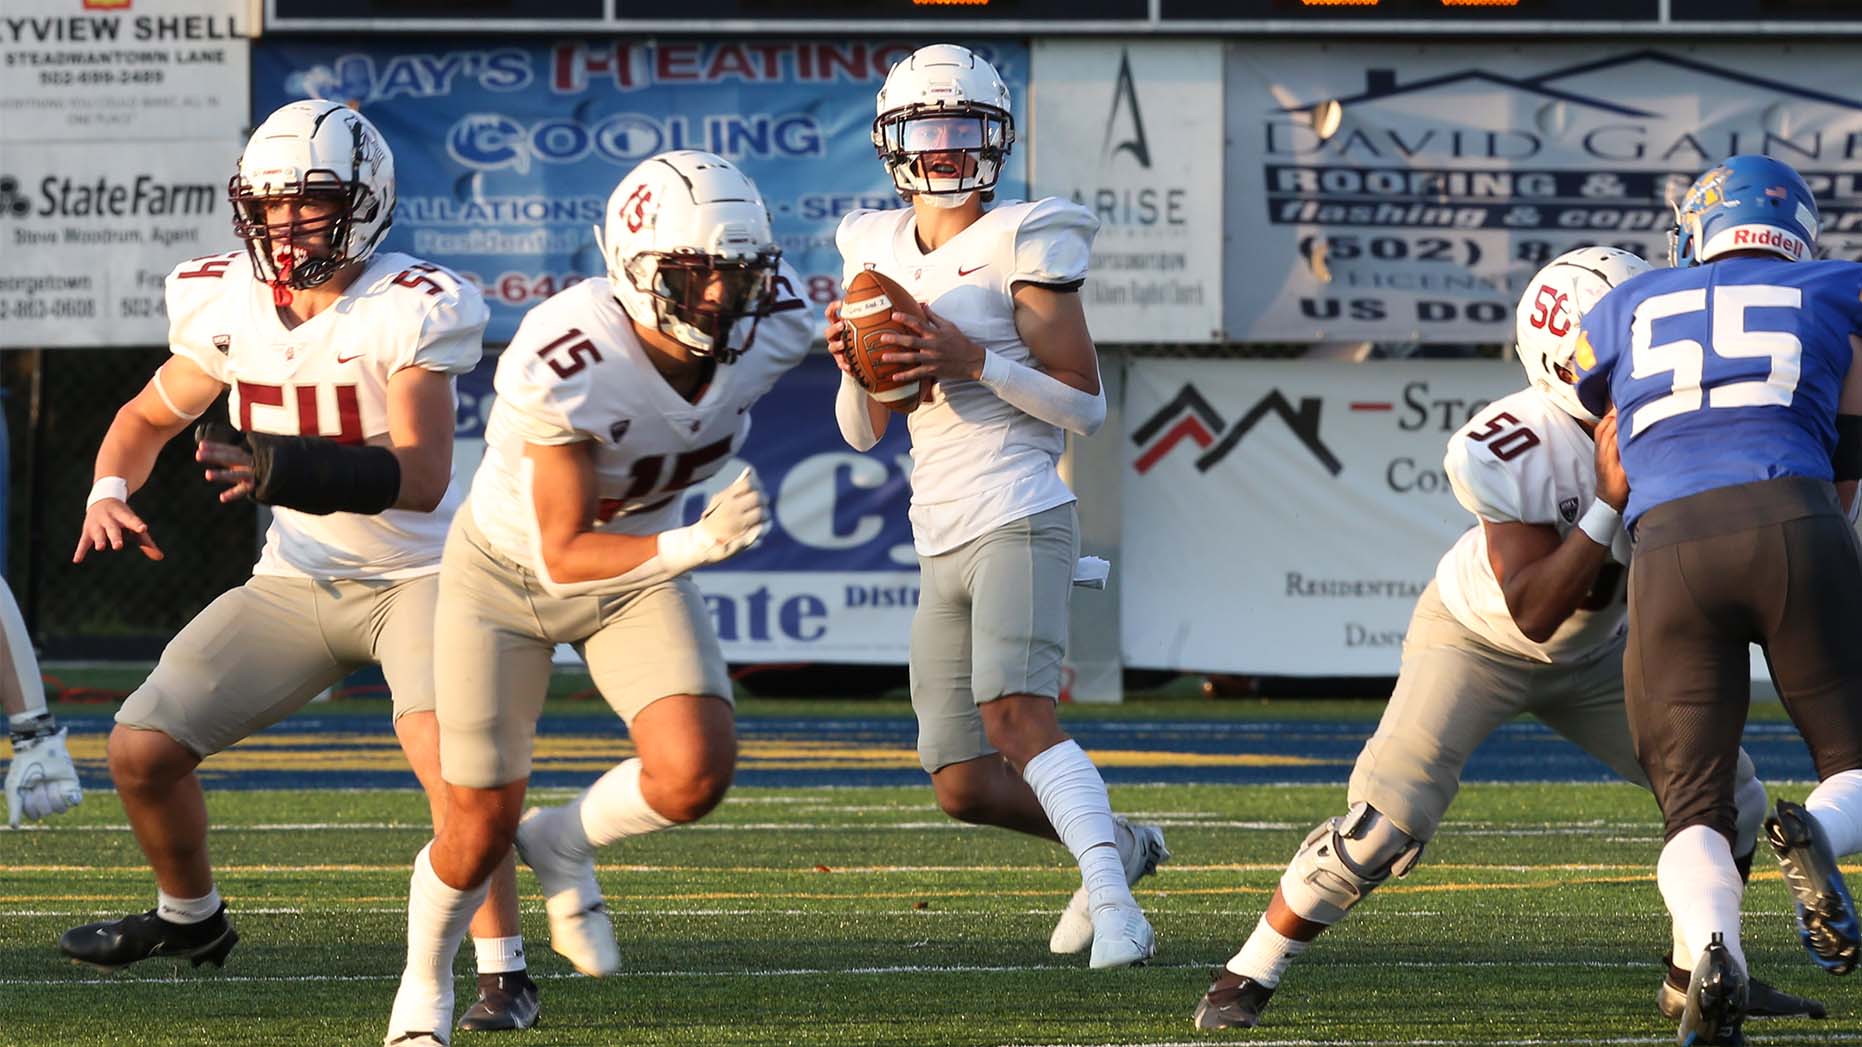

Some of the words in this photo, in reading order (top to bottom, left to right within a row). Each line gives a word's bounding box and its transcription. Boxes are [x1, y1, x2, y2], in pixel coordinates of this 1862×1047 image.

[0, 17, 121, 41] YVIEW
[134, 17, 245, 40] SHELL
[175, 50, 225, 64] LANE
[446, 114, 826, 170] COOLING
[1264, 119, 1543, 160] DAVID
[1277, 167, 1556, 198] ROOFING
[1580, 173, 1627, 198] &
[1281, 201, 1487, 228] flashing
[1504, 206, 1541, 226] &
[151, 228, 199, 246] Agent
[1298, 233, 1483, 268] (502)
[1733, 228, 1805, 258] Riddell
[1301, 299, 1389, 322] US
[537, 327, 603, 380] 15
[1630, 284, 1802, 438] 55
[1467, 411, 1541, 463] 50
[1285, 572, 1427, 598] RESIDENTIA
